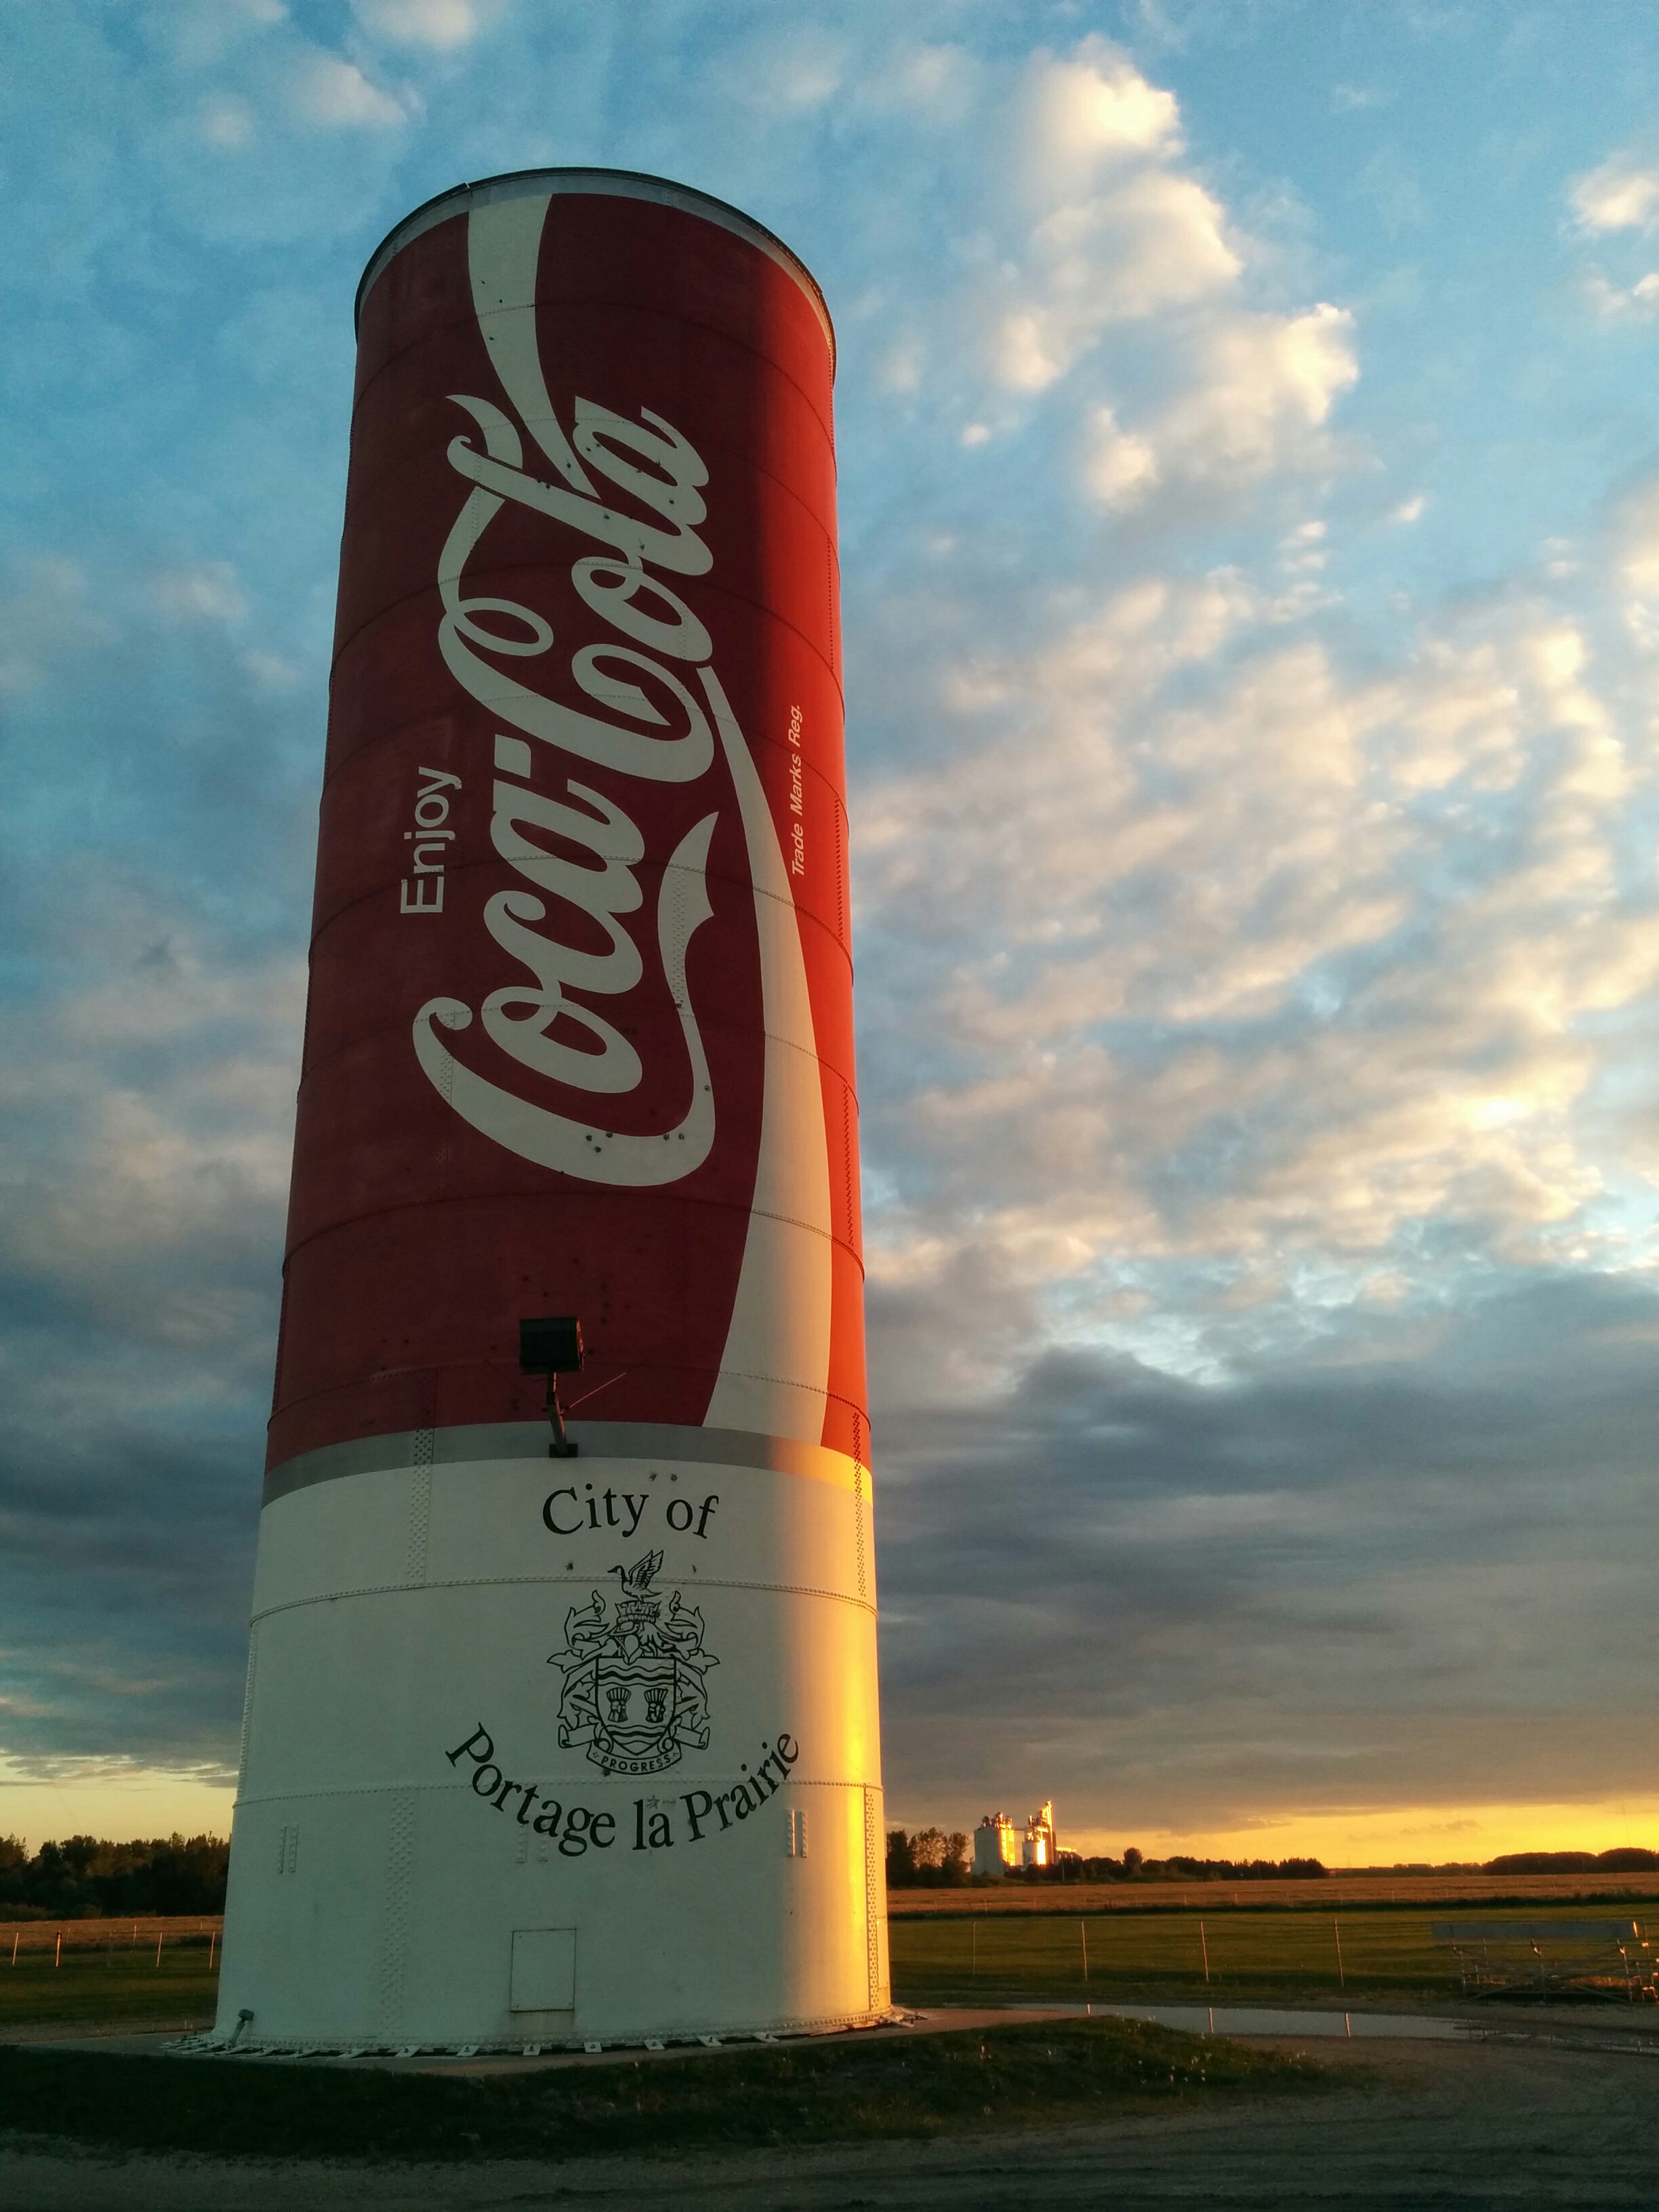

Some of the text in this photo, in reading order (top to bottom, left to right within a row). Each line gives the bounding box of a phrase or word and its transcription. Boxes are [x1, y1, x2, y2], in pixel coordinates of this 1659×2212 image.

[400, 766, 462, 914] Enjoy
[412, 394, 719, 1187] Coca-Cola
[787, 705, 804, 876] Trade Marks Reg.
[542, 1483, 719, 1540] City of
[445, 1721, 800, 1857] Portage la Prairie
[600, 1754, 671, 1772] PROGRESS
